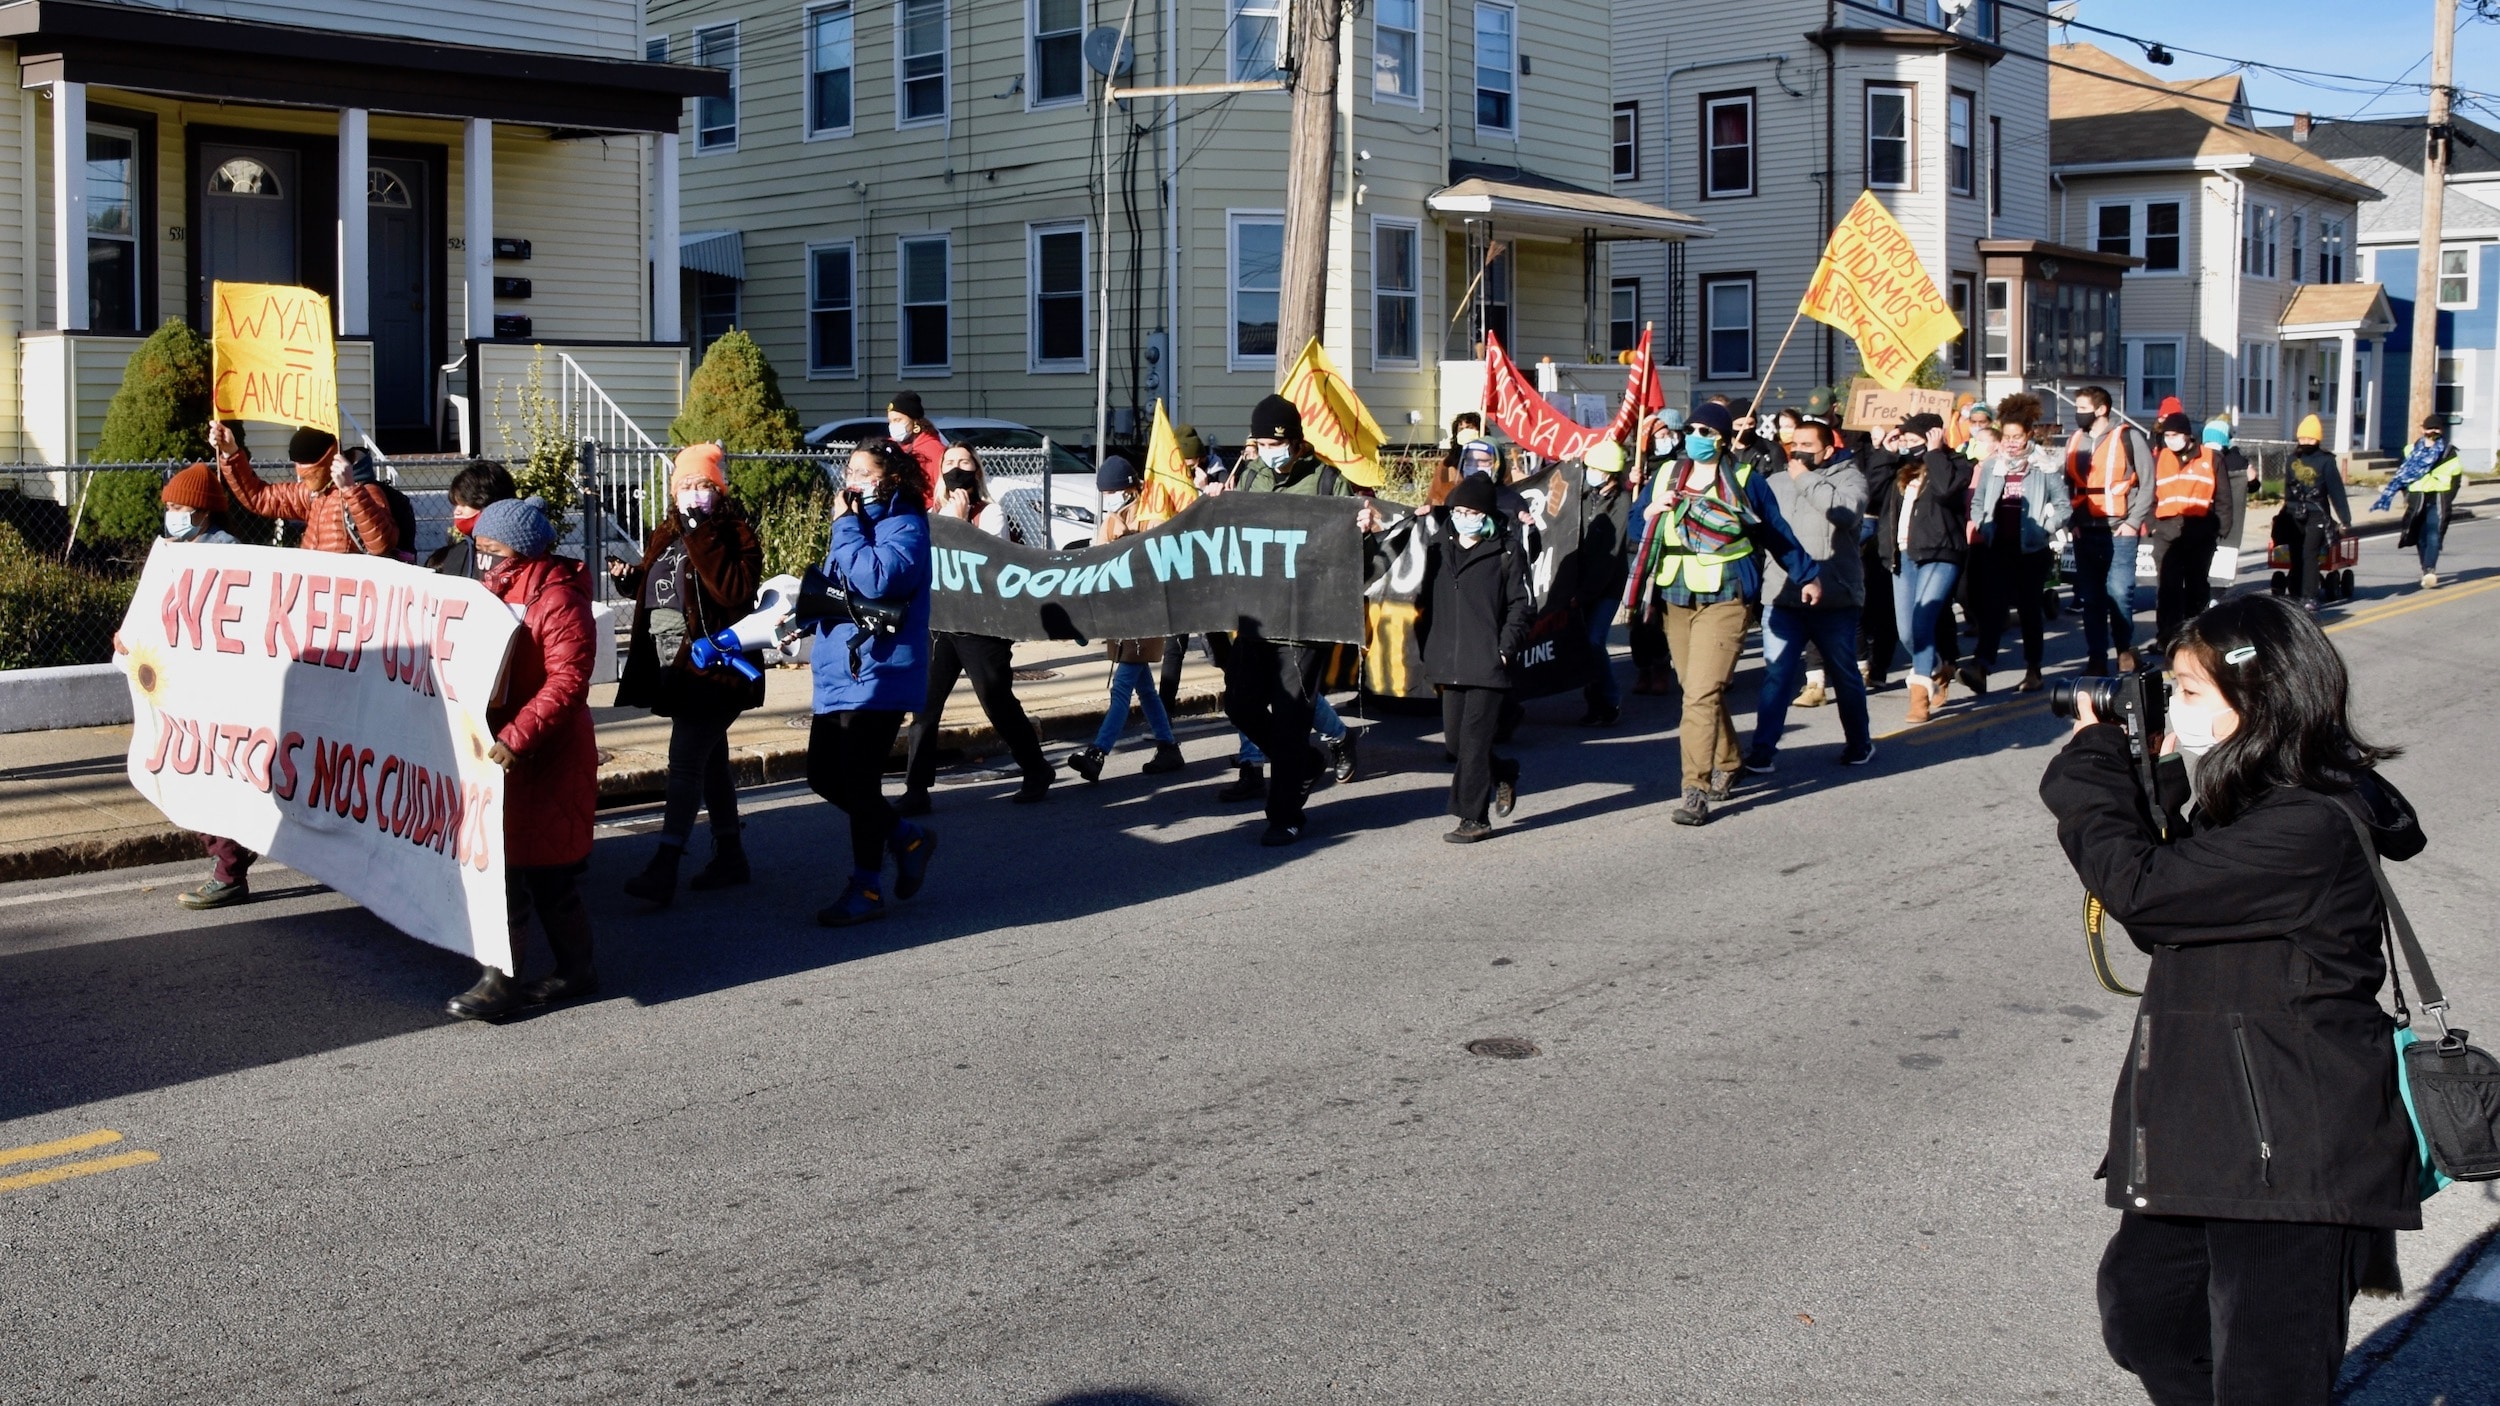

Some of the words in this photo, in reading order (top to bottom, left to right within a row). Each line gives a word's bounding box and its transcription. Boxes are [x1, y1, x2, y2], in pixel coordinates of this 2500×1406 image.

[169, 226, 184, 241] 531
[1849, 198, 1919, 278] NOSOTROS
[1829, 225, 1922, 327] CUIDAMOS
[221, 294, 325, 343] WYAT
[1863, 331, 1908, 380] SAFE
[214, 369, 336, 431] CANCELLE
[1862, 393, 1899, 419] Free
[1909, 391, 1951, 408] them
[1530, 409, 1561, 457] YA
[1144, 526, 1308, 582] WYATT
[161, 568, 252, 655] WE
[264, 571, 379, 673] KEEP
[382, 584, 415, 685] US
[1524, 640, 1556, 668] LINE
[145, 709, 305, 801] JUNTOS
[308, 736, 375, 823] NOS
[376, 755, 492, 873] CUIDAMOS
[2089, 897, 2101, 934] Nikon
